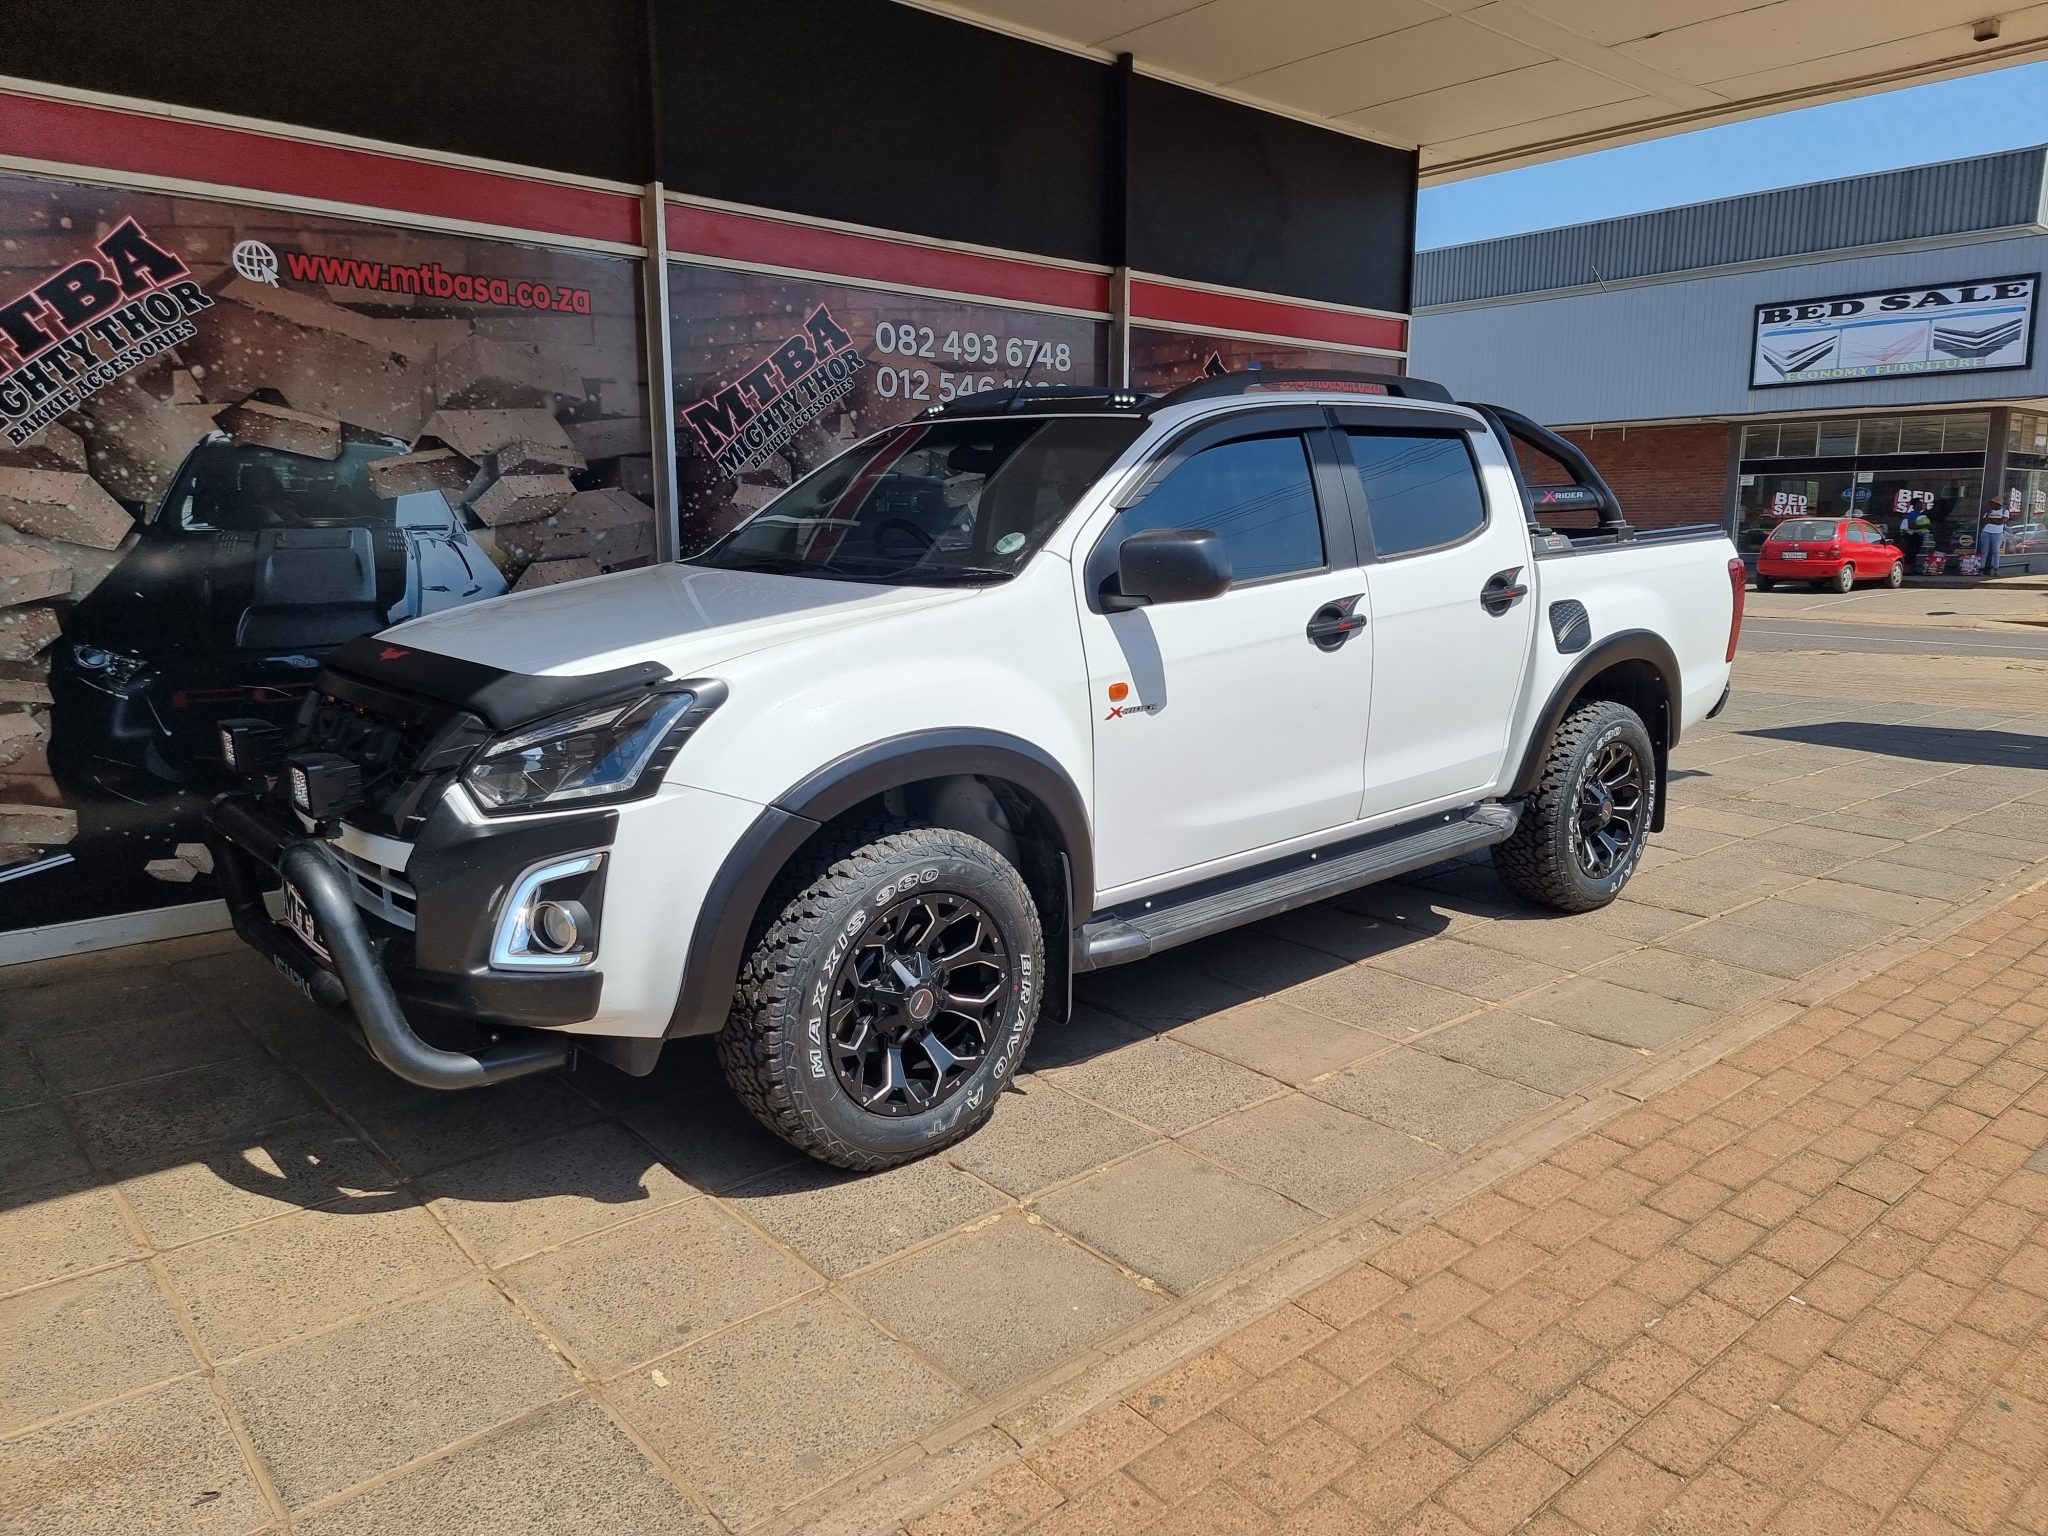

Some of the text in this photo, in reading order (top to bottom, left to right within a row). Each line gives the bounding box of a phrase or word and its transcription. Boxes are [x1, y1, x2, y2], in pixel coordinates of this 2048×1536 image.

[287, 251, 592, 314] www.mtbasa.co.za
[1761, 281, 2029, 325] BED SALE
[87, 281, 215, 353] THOR
[875, 321, 1072, 372] 082 493 6748
[1785, 357, 1985, 382] ECONOMY FURNITURE
[6, 319, 198, 447] BAKKIE ACCESSORIES
[682, 302, 854, 459] MTBA
[876, 366, 931, 401] 012
[716, 348, 866, 479] MIGHTY THOR
[750, 376, 855, 470] BAKKIE ACCESSORIES
[1540, 490, 1584, 504] X-RIDER
[1772, 504, 1808, 516] SALE
[1774, 491, 1808, 506] BED
[1897, 489, 1935, 503] BED
[2010, 487, 2022, 502] BED
[876, 868, 939, 907] 980
[809, 910, 867, 1078] MAXXIS
[994, 953, 1032, 1079] BRAVO
